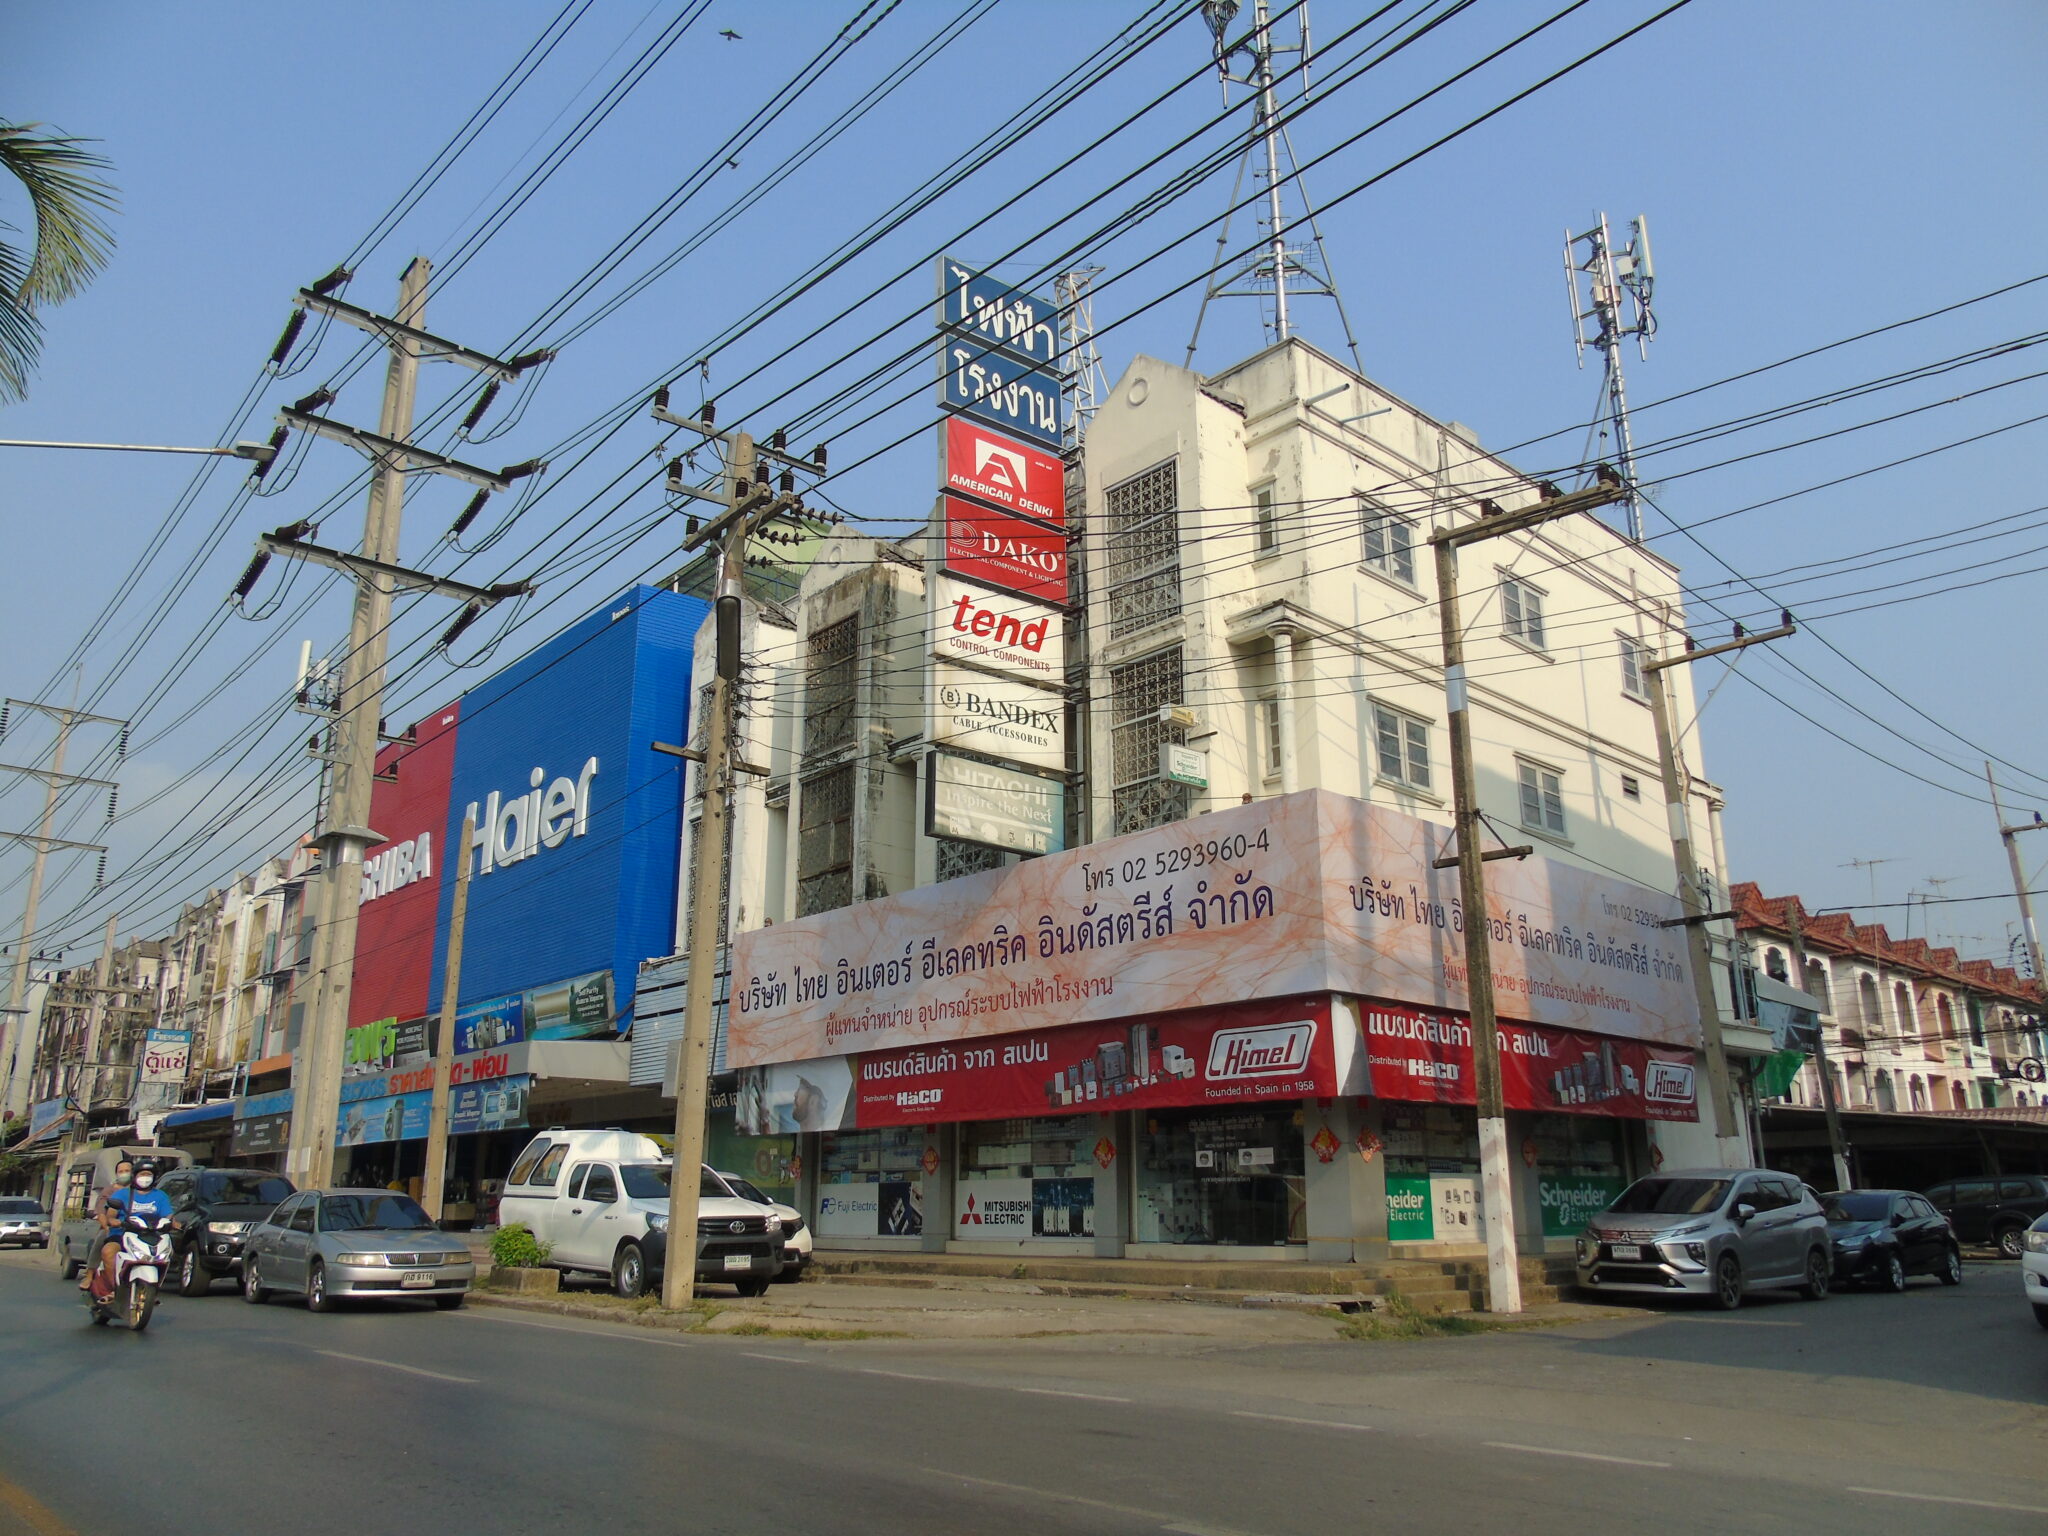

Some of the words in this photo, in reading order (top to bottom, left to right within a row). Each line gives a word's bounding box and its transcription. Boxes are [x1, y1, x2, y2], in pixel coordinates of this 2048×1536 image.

[951, 265, 1054, 361] ไฟฟ้า
[953, 348, 1057, 434] โรงงาน
[951, 473, 1012, 503] AMERICAN
[1018, 497, 1053, 518] DENKI
[949, 547, 990, 565] ELECTRICAL
[990, 558, 1028, 576] COMPONENT
[1034, 572, 1064, 587] LIGHTING
[952, 594, 1049, 653] tend
[950, 637, 990, 656] CONTROL
[993, 649, 1050, 672] COMPONENTS
[953, 715, 982, 731] CABLE
[986, 724, 1048, 747] ACCESSORIES
[966, 692, 1059, 734] BANDEX
[953, 766, 1047, 807] HITACHI
[465, 756, 599, 882] Haier
[998, 801, 1019, 816] the
[1023, 806, 1053, 824] Next
[1082, 863, 1114, 892] โทร
[1122, 858, 1147, 883] 02
[1155, 827, 1270, 877] 5293960-4
[1349, 876, 1405, 920] บริษัท
[1409, 884, 1445, 929] ไทย
[1517, 913, 1583, 960] อีเลคทริค
[1587, 932, 1649, 975] อินดัสตรีส์
[1652, 948, 1684, 984] จำกัด
[1620, 904, 1632, 922] 02
[739, 971, 787, 1013] บริษัท
[794, 965, 828, 1003] ไทย
[837, 940, 913, 996] อินเตอร์
[921, 924, 1027, 980] อีเลคทริค
[1038, 885, 1173, 959] อินดัสตรีส์
[1187, 870, 1274, 930] จำกัด
[826, 1003, 913, 1045] ผู้แทนจำหน่าย
[918, 974, 1114, 1031] อุปกรณ์ระบบไฟฟ้าโรงงาน
[1223, 1033, 1296, 1075] Himel
[1368, 1012, 1472, 1047] แบรนด์สินค้า
[1512, 1031, 1549, 1058] สเปน
[146, 1050, 187, 1075] ตู้แช่
[863, 1047, 957, 1082] แบรนด์สินค้า
[963, 1047, 996, 1070] จาก
[1003, 1038, 1049, 1065] สเปน
[1368, 1054, 1402, 1066] Distributed
[863, 1094, 889, 1104] Distributed
[1205, 1086, 1241, 1098] Founded
[1244, 1085, 1252, 1095] in
[1255, 1083, 1279, 1096] Spain
[1282, 1082, 1290, 1092] in
[1295, 1080, 1315, 1092] 1958
[1653, 1070, 1687, 1097] Himel
[838, 1201, 850, 1213] Fuji
[852, 1201, 877, 1212] Electric
[984, 1200, 1032, 1212] MITSUBISHI
[1540, 1182, 1606, 1206] Schneider
[984, 1213, 1025, 1225] ELECTRIC
[1390, 1209, 1424, 1221] Electric
